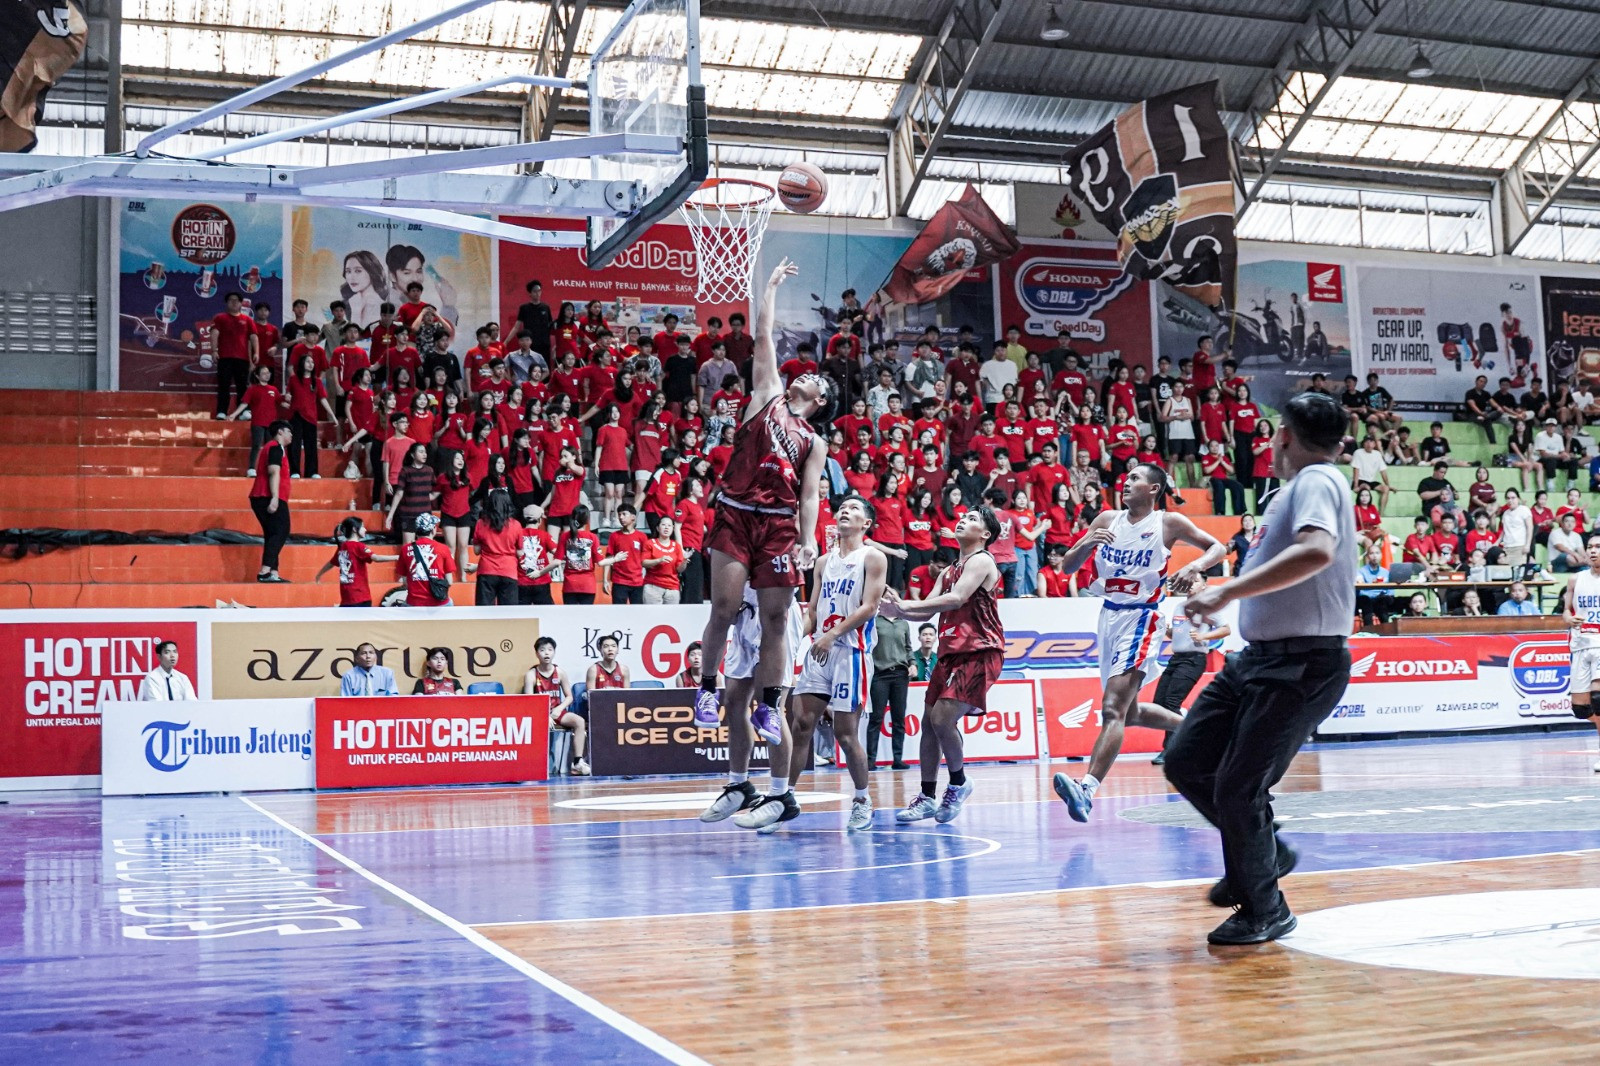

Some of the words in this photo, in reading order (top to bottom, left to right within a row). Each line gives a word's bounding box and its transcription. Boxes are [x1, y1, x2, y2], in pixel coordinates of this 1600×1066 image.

[182, 234, 225, 249] CREAM
[648, 240, 699, 278] Day
[553, 279, 587, 288] KARENA
[589, 280, 612, 290] HIDUP
[615, 281, 638, 290] PERLU
[641, 282, 670, 292] BANYAK
[675, 284, 693, 293] RASA
[1049, 274, 1103, 285] HONDA
[1049, 290, 1076, 304] DBL
[1081, 321, 1102, 336] Day
[1377, 319, 1405, 338] GEAR
[1408, 320, 1424, 340] UP,
[1564, 326, 1591, 336] ICE
[1371, 343, 1397, 361] PLAY
[1401, 344, 1433, 363] HARD,
[773, 554, 790, 573] 99
[1101, 544, 1153, 568] SEBELAS
[1376, 659, 1473, 677] HONDA
[1535, 669, 1560, 683] DBL
[834, 683, 849, 699] 15
[1348, 704, 1366, 715] DBL
[1436, 702, 1499, 712] AZAWEAR.COM
[1540, 699, 1564, 711] Good
[26, 718, 54, 727] UNTUK
[55, 717, 82, 727] PEGAL
[84, 717, 101, 726] DAN
[431, 716, 532, 747] CREAM
[617, 728, 669, 745] ICE
[142, 720, 241, 773] Tribun
[246, 726, 313, 761] Jateng
[349, 754, 386, 765] UNTUK
[388, 752, 424, 764] PEGAL
[427, 752, 450, 763] DAN
[452, 750, 518, 762] PEMANASAN
